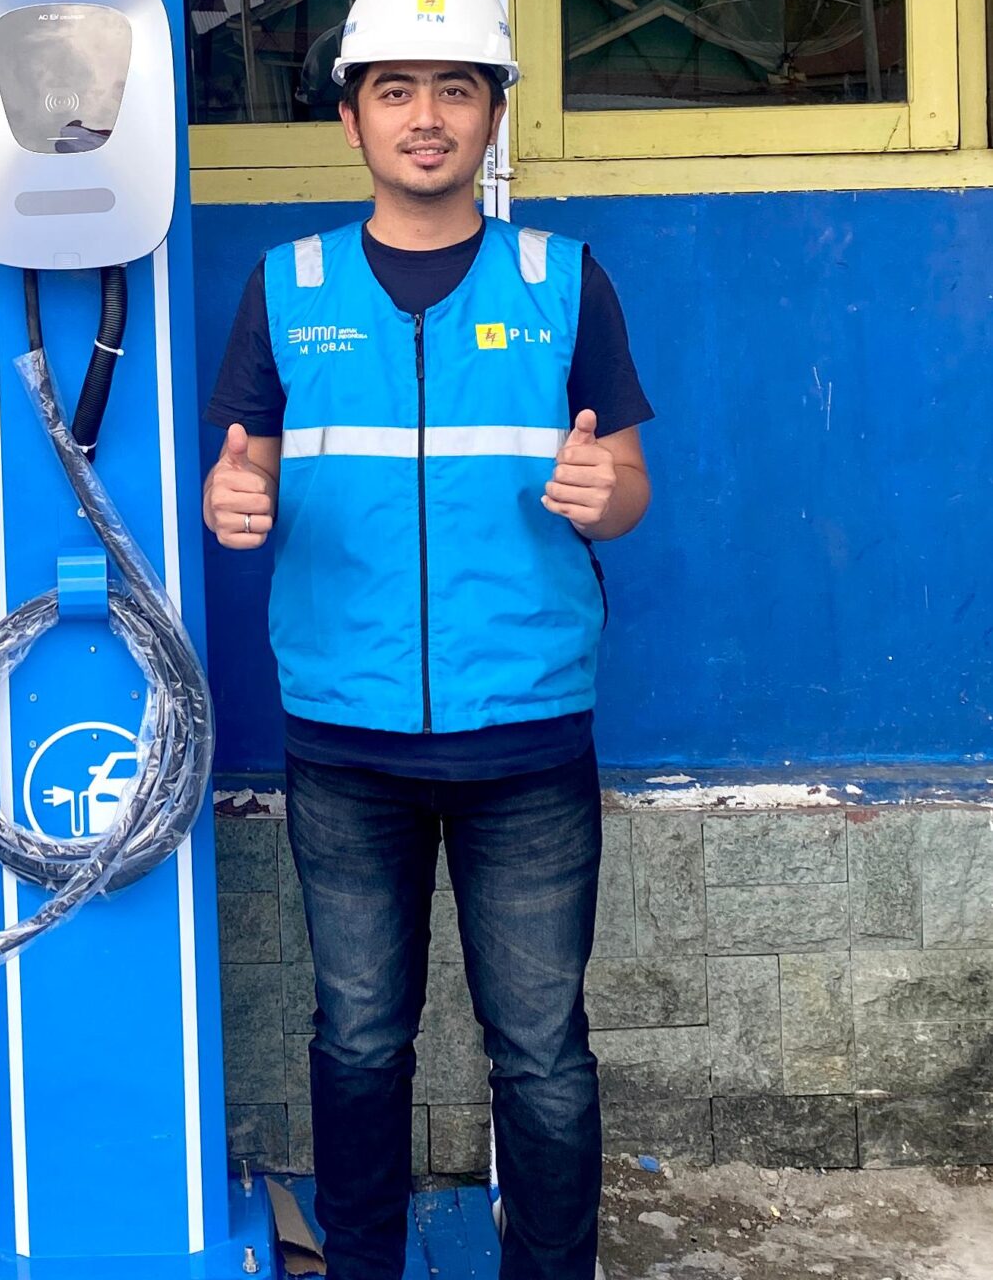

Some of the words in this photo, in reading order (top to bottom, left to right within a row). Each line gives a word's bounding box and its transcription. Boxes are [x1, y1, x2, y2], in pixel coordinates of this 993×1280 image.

[417, 13, 445, 23] PLN
[509, 329, 552, 344] PLN
[299, 344, 309, 355] M
